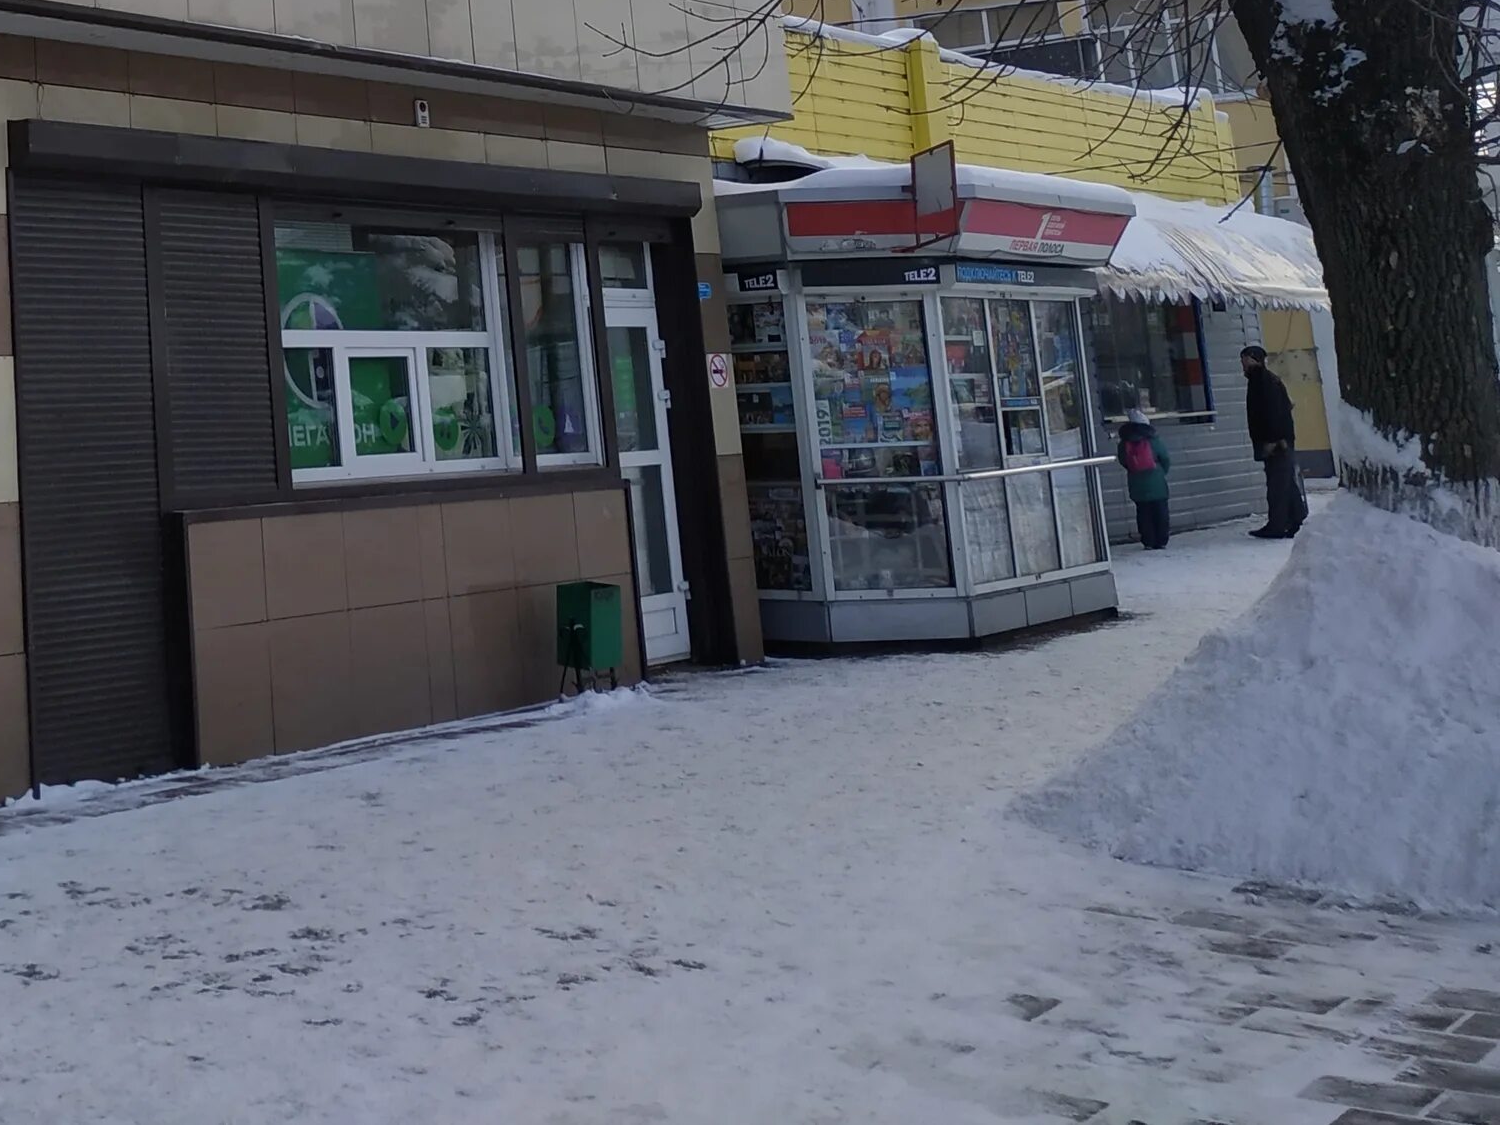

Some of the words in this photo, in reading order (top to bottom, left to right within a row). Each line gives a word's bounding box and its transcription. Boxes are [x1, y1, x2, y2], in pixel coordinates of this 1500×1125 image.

[1009, 240, 1038, 253] ПЕРВАЯ
[1038, 241, 1065, 254] ПОЛОСА
[744, 274, 775, 289] TELE2
[904, 267, 937, 282] TELE2
[1017, 270, 1035, 283] TELE2
[817, 409, 832, 445] 2019
[288, 423, 376, 447] ЕГАОН
